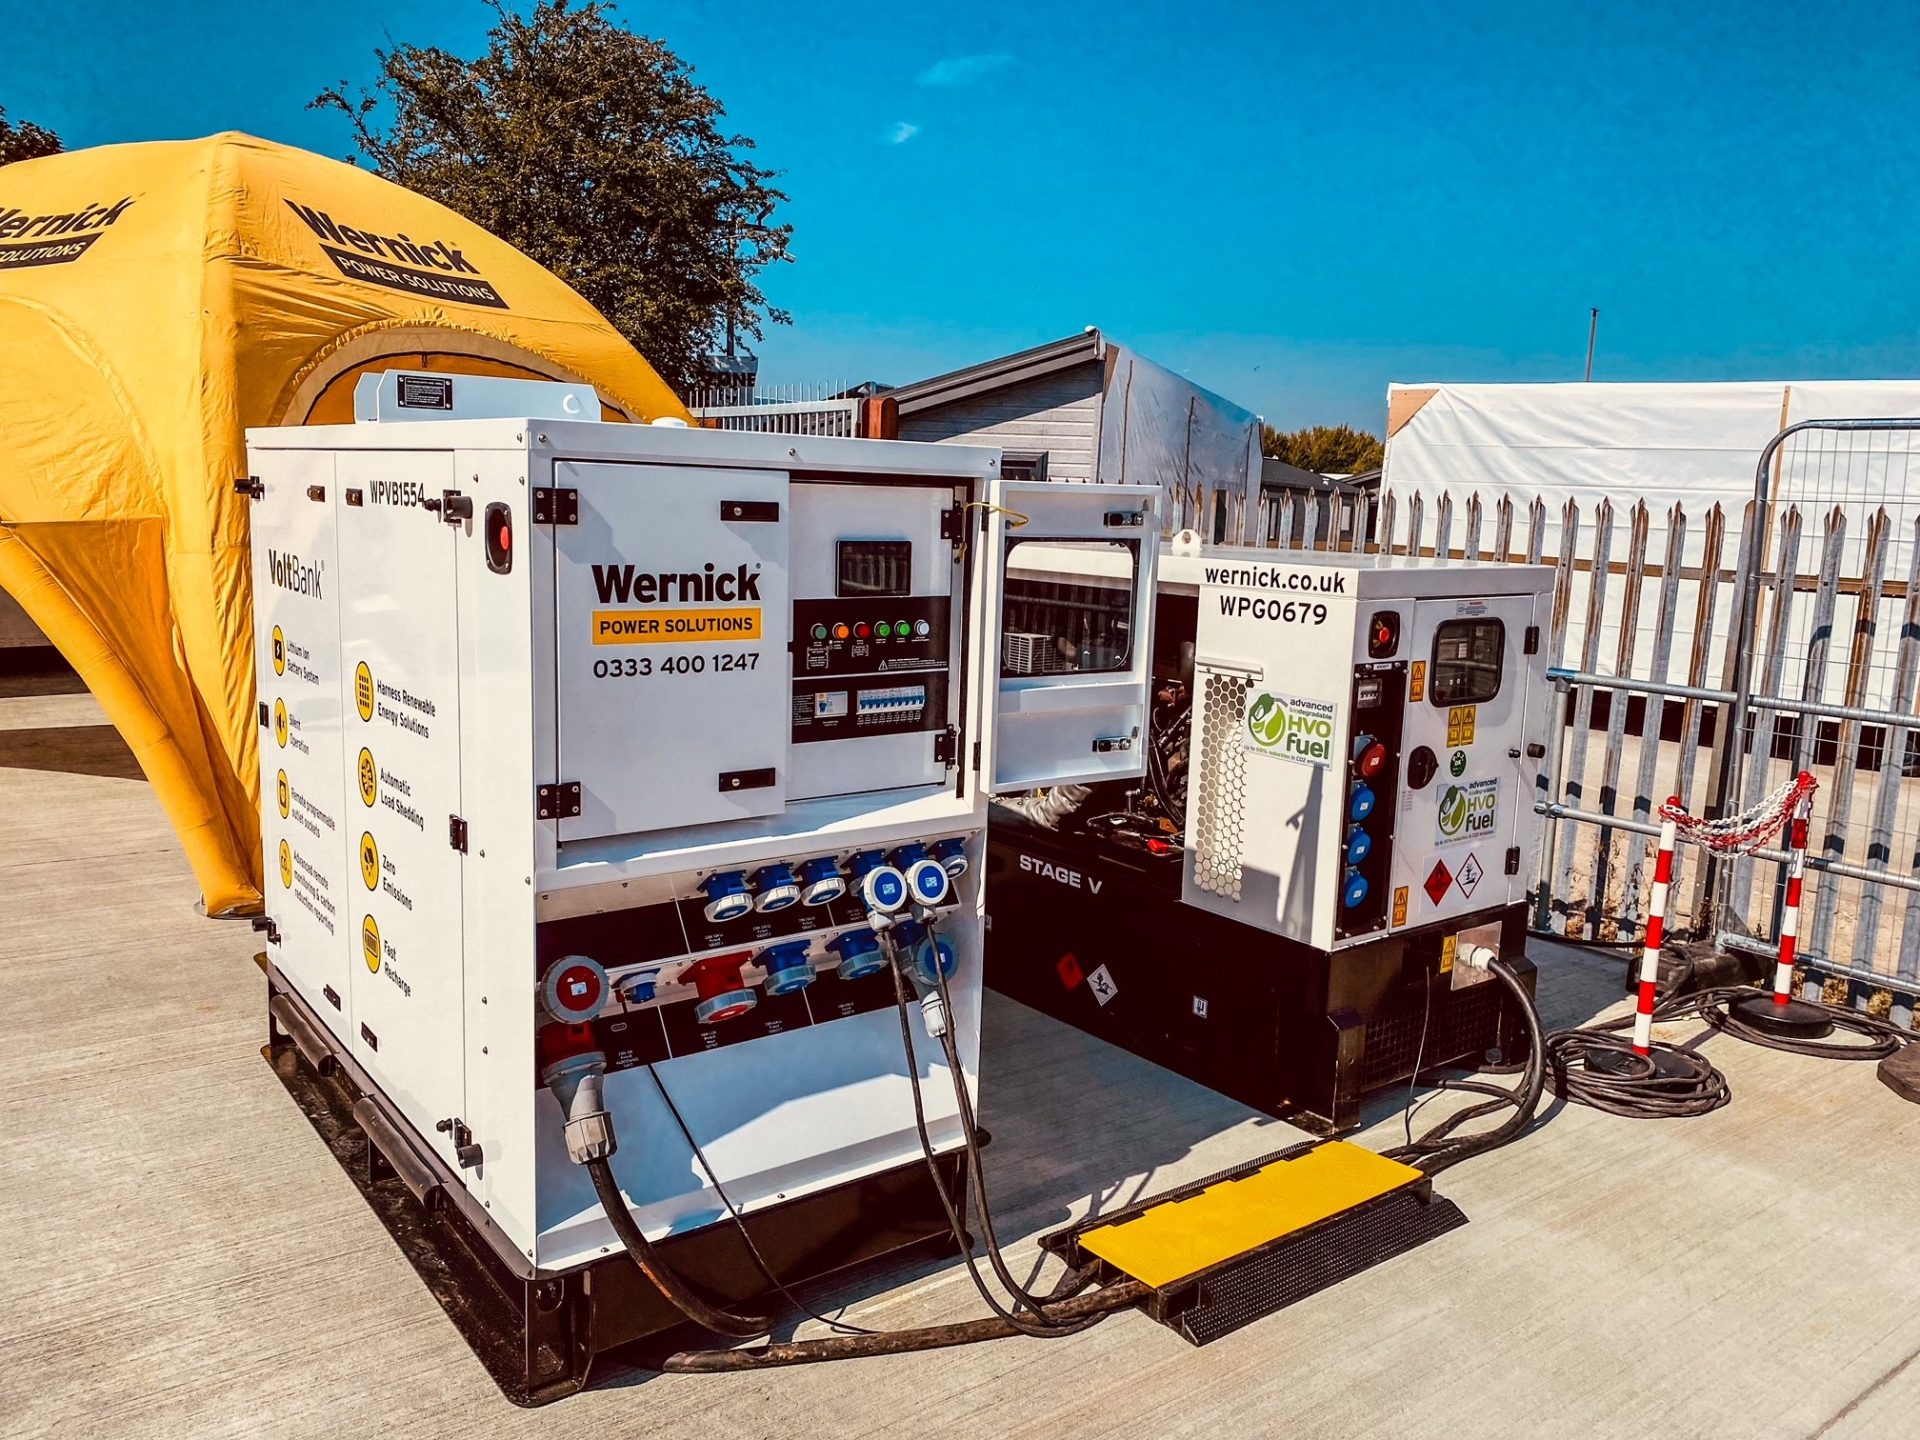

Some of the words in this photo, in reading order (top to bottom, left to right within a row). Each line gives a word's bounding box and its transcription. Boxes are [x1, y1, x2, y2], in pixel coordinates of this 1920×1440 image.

[336, 255, 402, 283] POWER
[404, 272, 495, 301] SOLUTIONS
[369, 479, 426, 508] WPVB1554
[268, 548, 322, 600] VoltBank
[1205, 565, 1346, 594] wernick.co.uk
[1219, 594, 1328, 626] WPG0679
[600, 619, 660, 635] POWER
[664, 616, 753, 633] SOLUTIONS
[593, 657, 652, 679] 0333
[660, 655, 705, 675] 400
[712, 652, 760, 672] 1247
[376, 679, 401, 702] Harness
[402, 689, 436, 717] Renewable
[1289, 698, 1334, 713] advanced
[378, 702, 398, 727] Energy
[400, 711, 429, 739] Solutions
[1287, 714, 1332, 738] HVO
[380, 767, 411, 797] Automatic
[1469, 777, 1498, 789] advanced
[380, 789, 395, 811] Load
[396, 800, 424, 832] Shedding
[1467, 793, 1496, 813] HVO
[382, 854, 396, 876] Zero
[1019, 853, 1082, 889] STAGE
[1087, 876, 1103, 895] V
[382, 876, 413, 911] Emissions
[384, 940, 397, 962] Fast
[384, 961, 411, 997] Recharge
